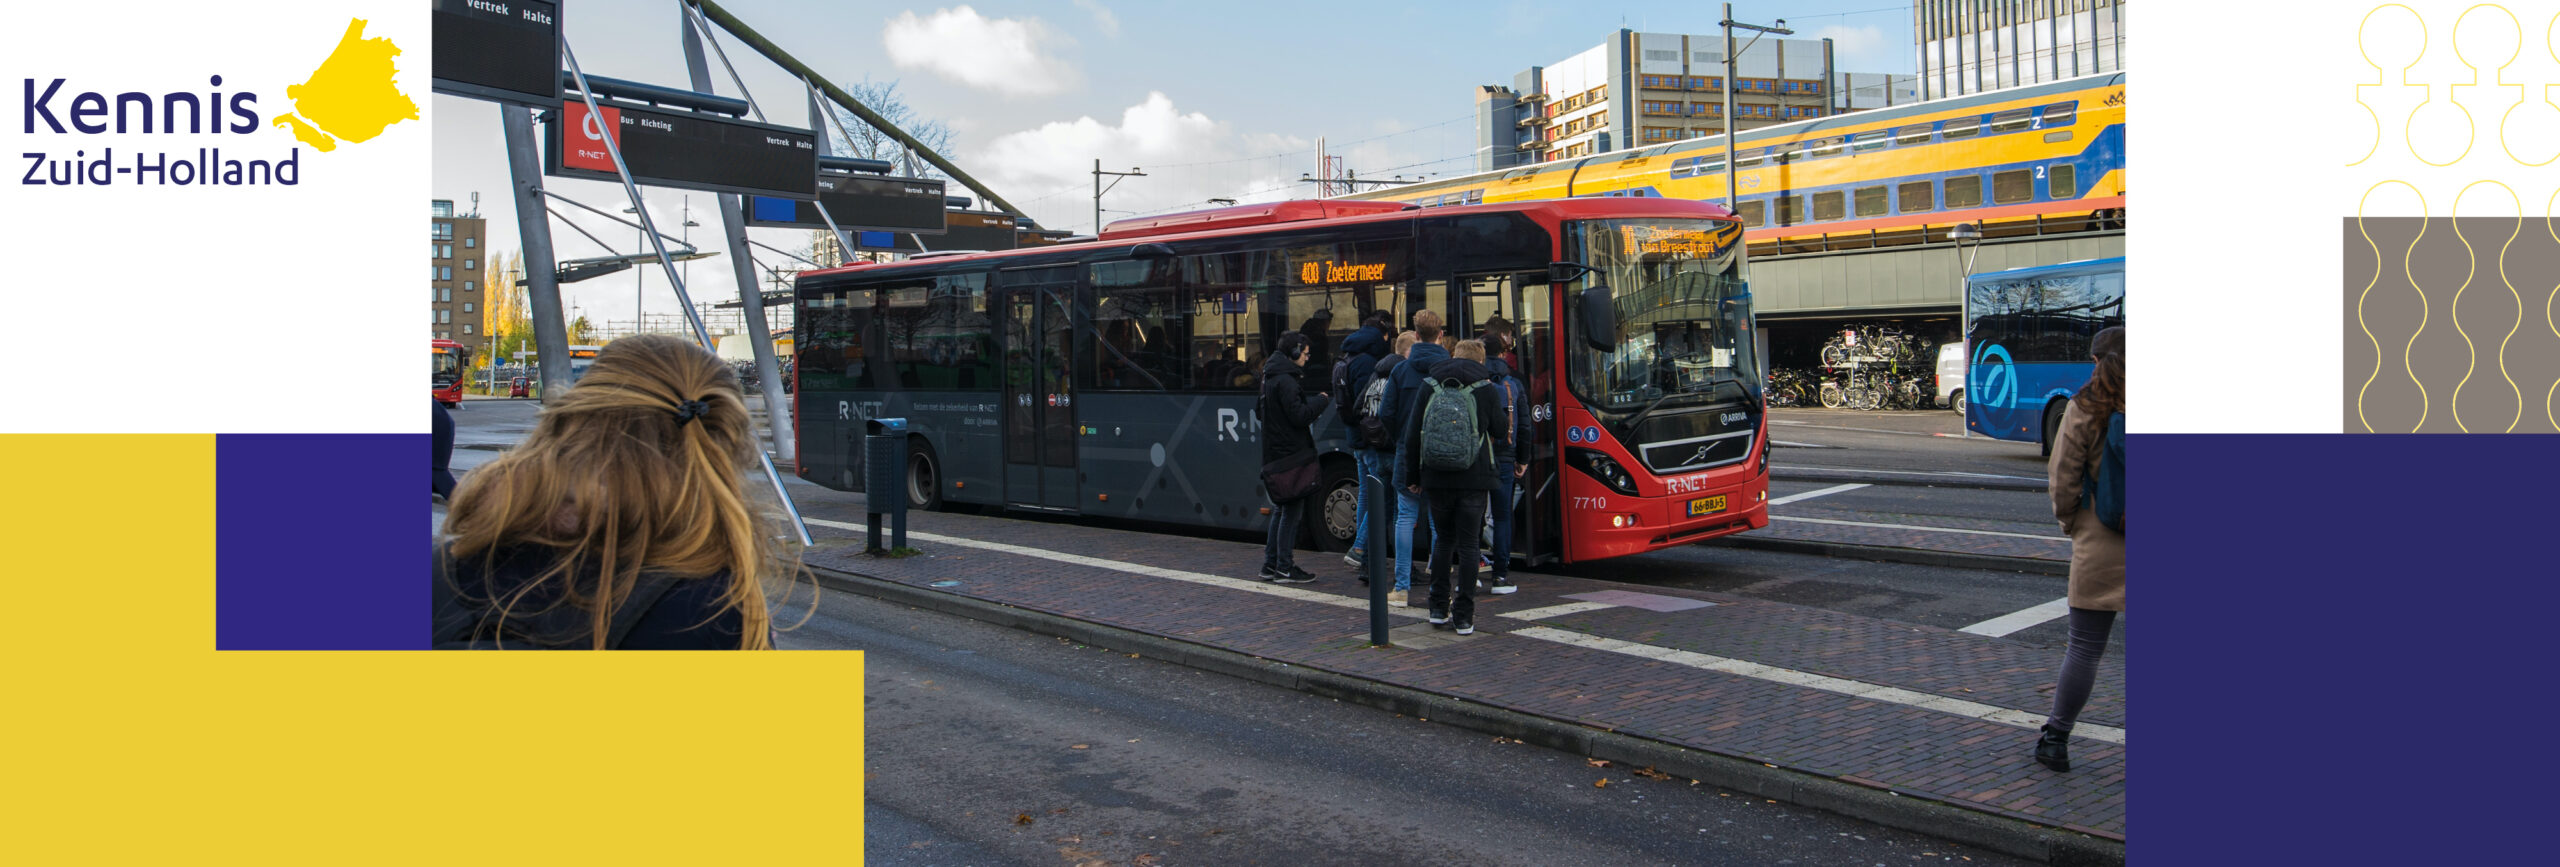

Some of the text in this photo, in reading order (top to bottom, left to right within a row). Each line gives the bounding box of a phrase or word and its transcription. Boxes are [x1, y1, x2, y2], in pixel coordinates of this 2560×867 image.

[467, 0, 552, 25] Vertrek Halte
[620, 116, 673, 132] Bus Richting
[2032, 116, 2041, 129] 2
[766, 136, 813, 150] Vertrek Halte
[2036, 166, 2045, 179] 2
[818, 180, 834, 189] hting
[904, 187, 924, 195] Vertrek
[1302, 260, 1386, 284] 400 Zoetermeer
[1728, 411, 1747, 421] ARRIVA
[1573, 496, 1606, 510] 7710
[1693, 498, 1725, 512] 66-BBJ-5
